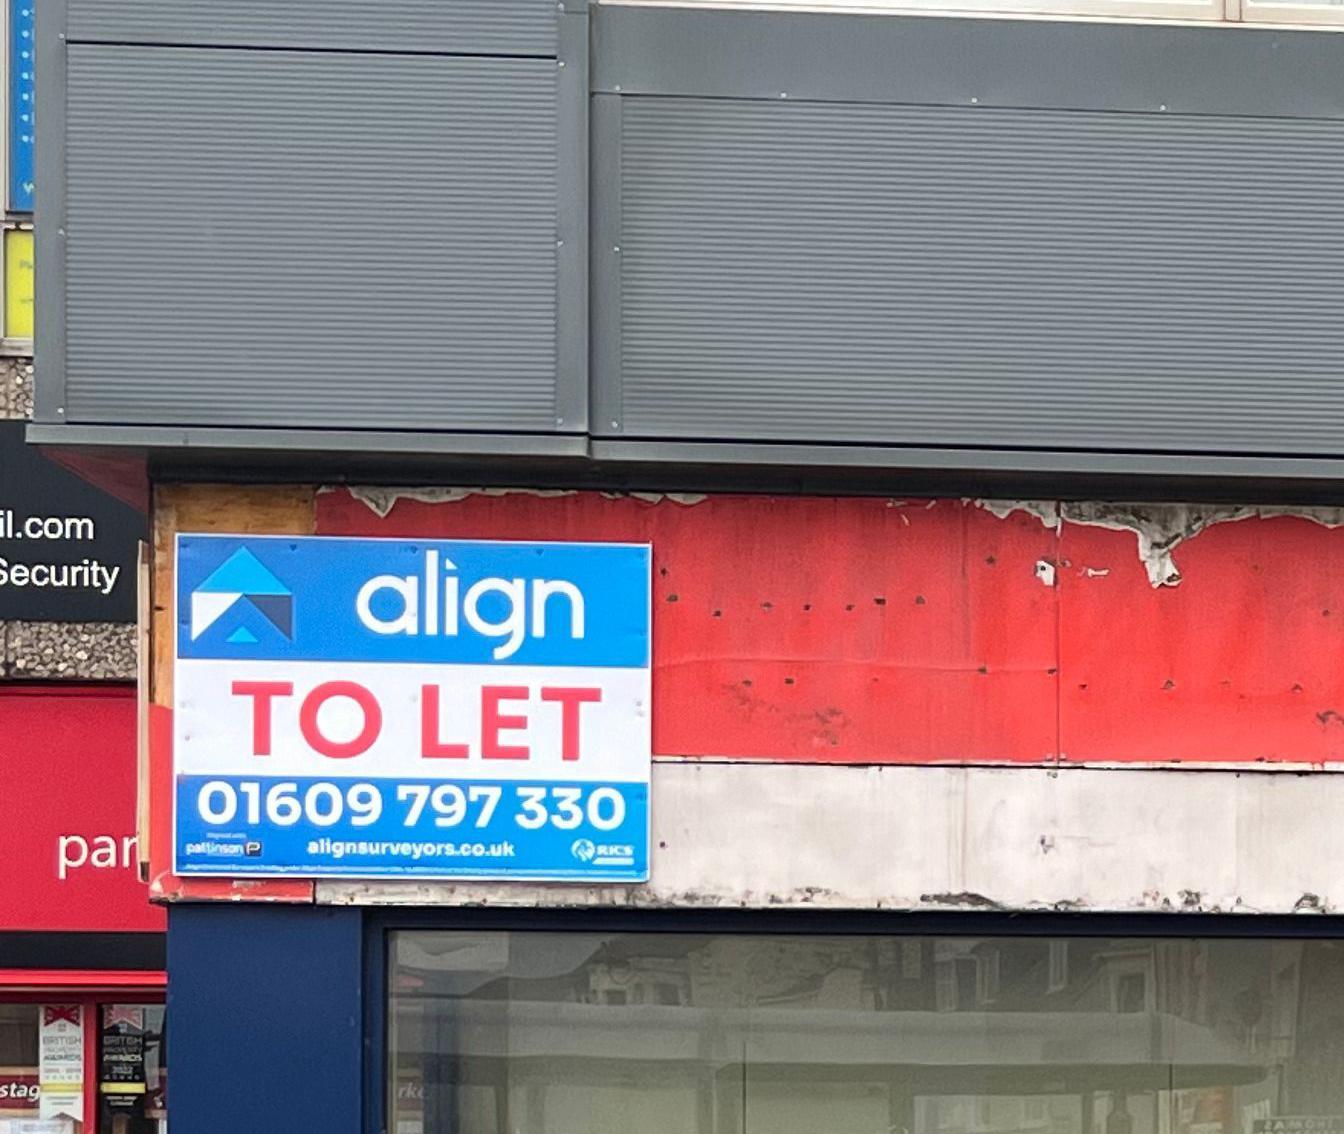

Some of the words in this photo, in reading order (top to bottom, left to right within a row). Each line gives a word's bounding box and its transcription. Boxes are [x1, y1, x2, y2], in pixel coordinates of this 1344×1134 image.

[355, 549, 586, 661] align
[230, 679, 384, 761] TO
[420, 682, 604, 763] LET
[196, 780, 383, 829] 01609
[396, 783, 503, 830] 797
[514, 785, 627, 832] 330
[307, 838, 516, 860] alignsurveyors.co.uk
